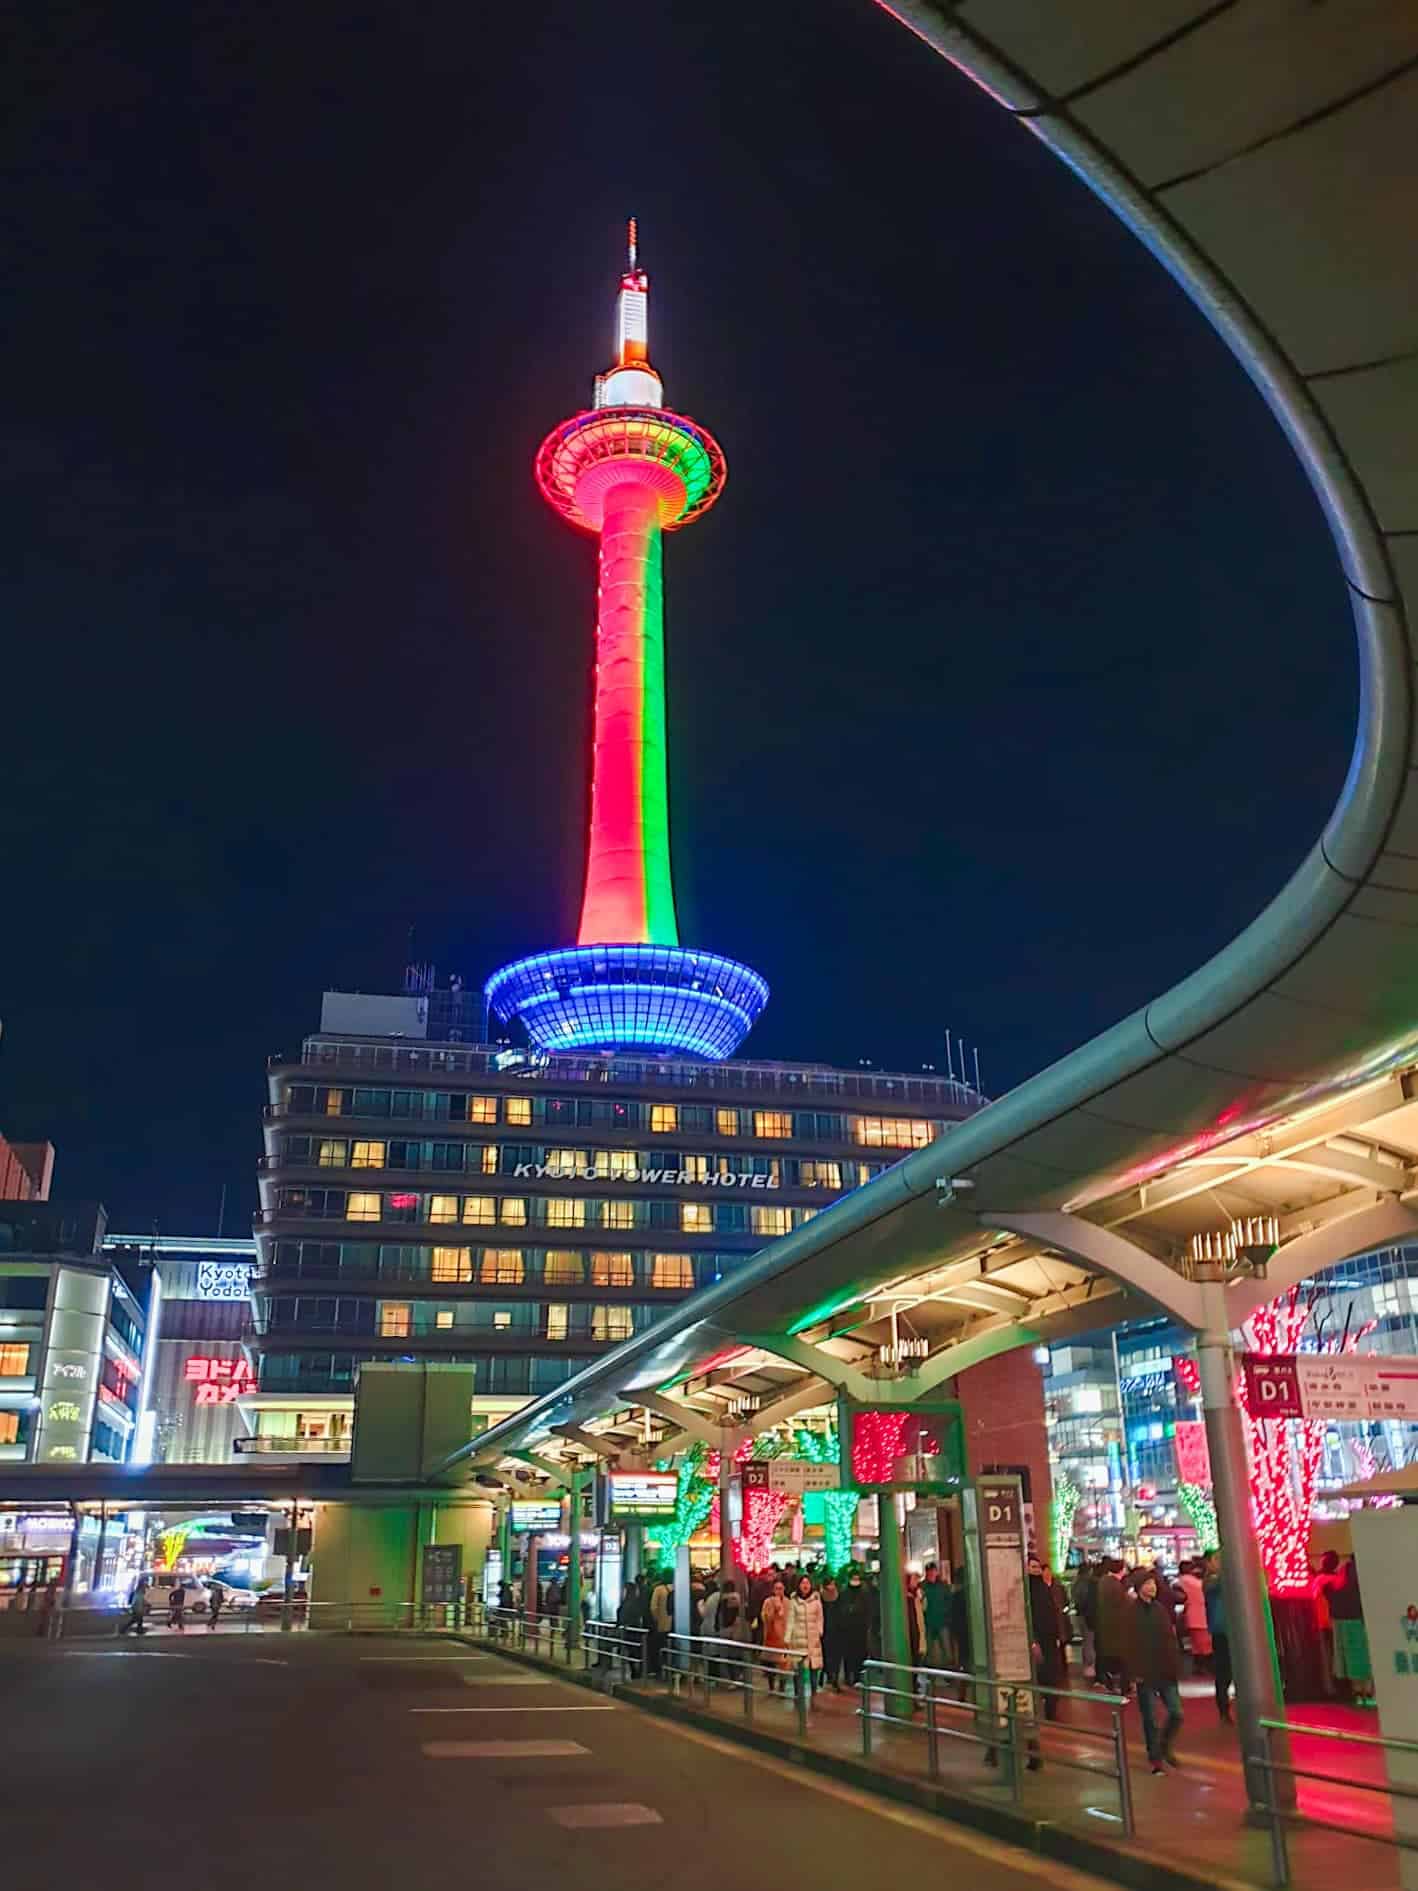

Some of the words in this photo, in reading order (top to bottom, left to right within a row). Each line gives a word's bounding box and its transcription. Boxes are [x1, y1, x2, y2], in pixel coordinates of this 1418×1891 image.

[513, 1163, 598, 1182] KYOTO
[609, 1167, 693, 1185] TOWER
[701, 1171, 781, 1189] HOTEL
[1261, 1380, 1289, 1401] D1
[748, 1473, 765, 1484] D2
[989, 1504, 1012, 1522] D1
